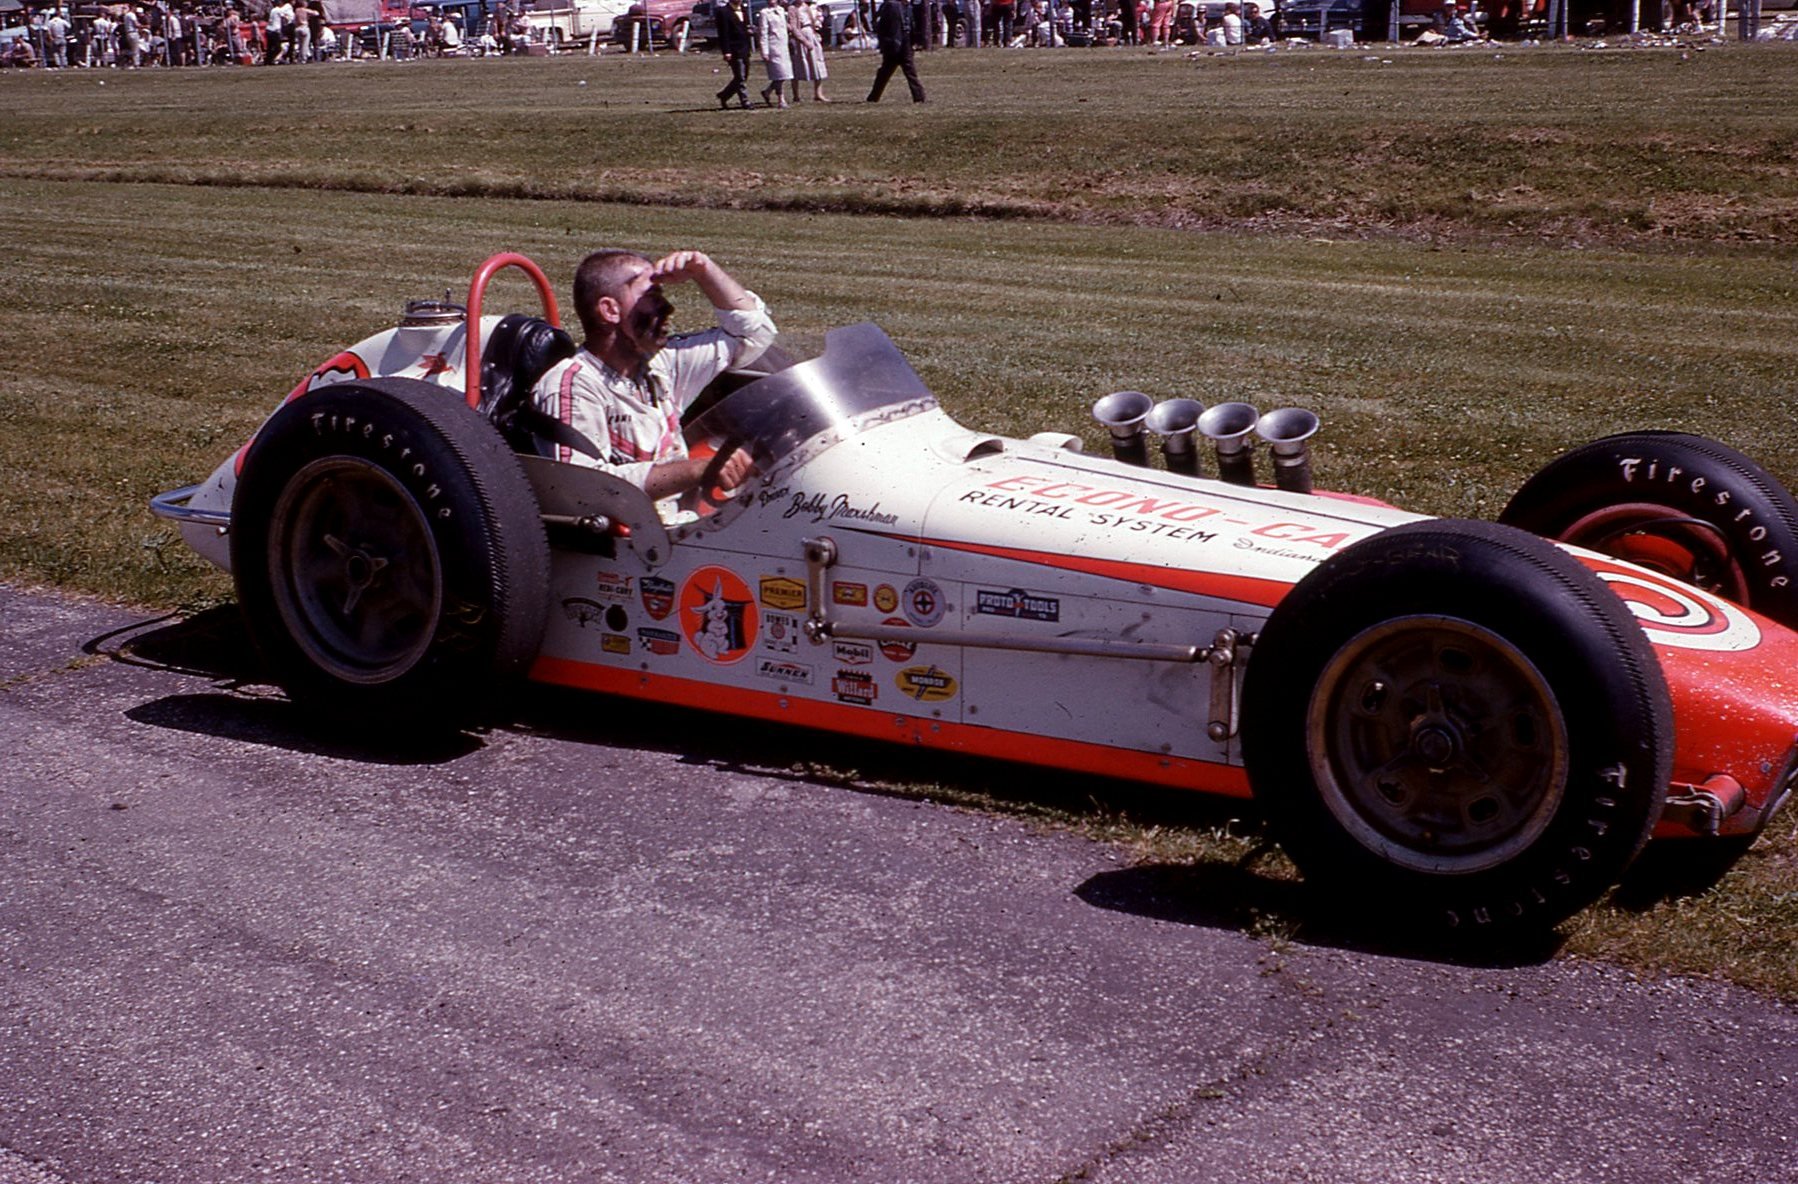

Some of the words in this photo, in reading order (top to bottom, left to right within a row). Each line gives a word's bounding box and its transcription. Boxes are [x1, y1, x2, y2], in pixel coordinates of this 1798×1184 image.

[311, 412, 452, 520] Firestone
[783, 491, 828, 524] Bobby
[961, 490, 1076, 520] RENTAL
[1091, 512, 1219, 543] SYSTEM
[1619, 457, 1790, 588] Firestone
[763, 585, 803, 598] PREMIER
[979, 593, 1015, 609] PROTO
[1023, 598, 1058, 614] TOOLS
[836, 645, 869, 658] Mobil
[911, 675, 945, 687] MONROE
